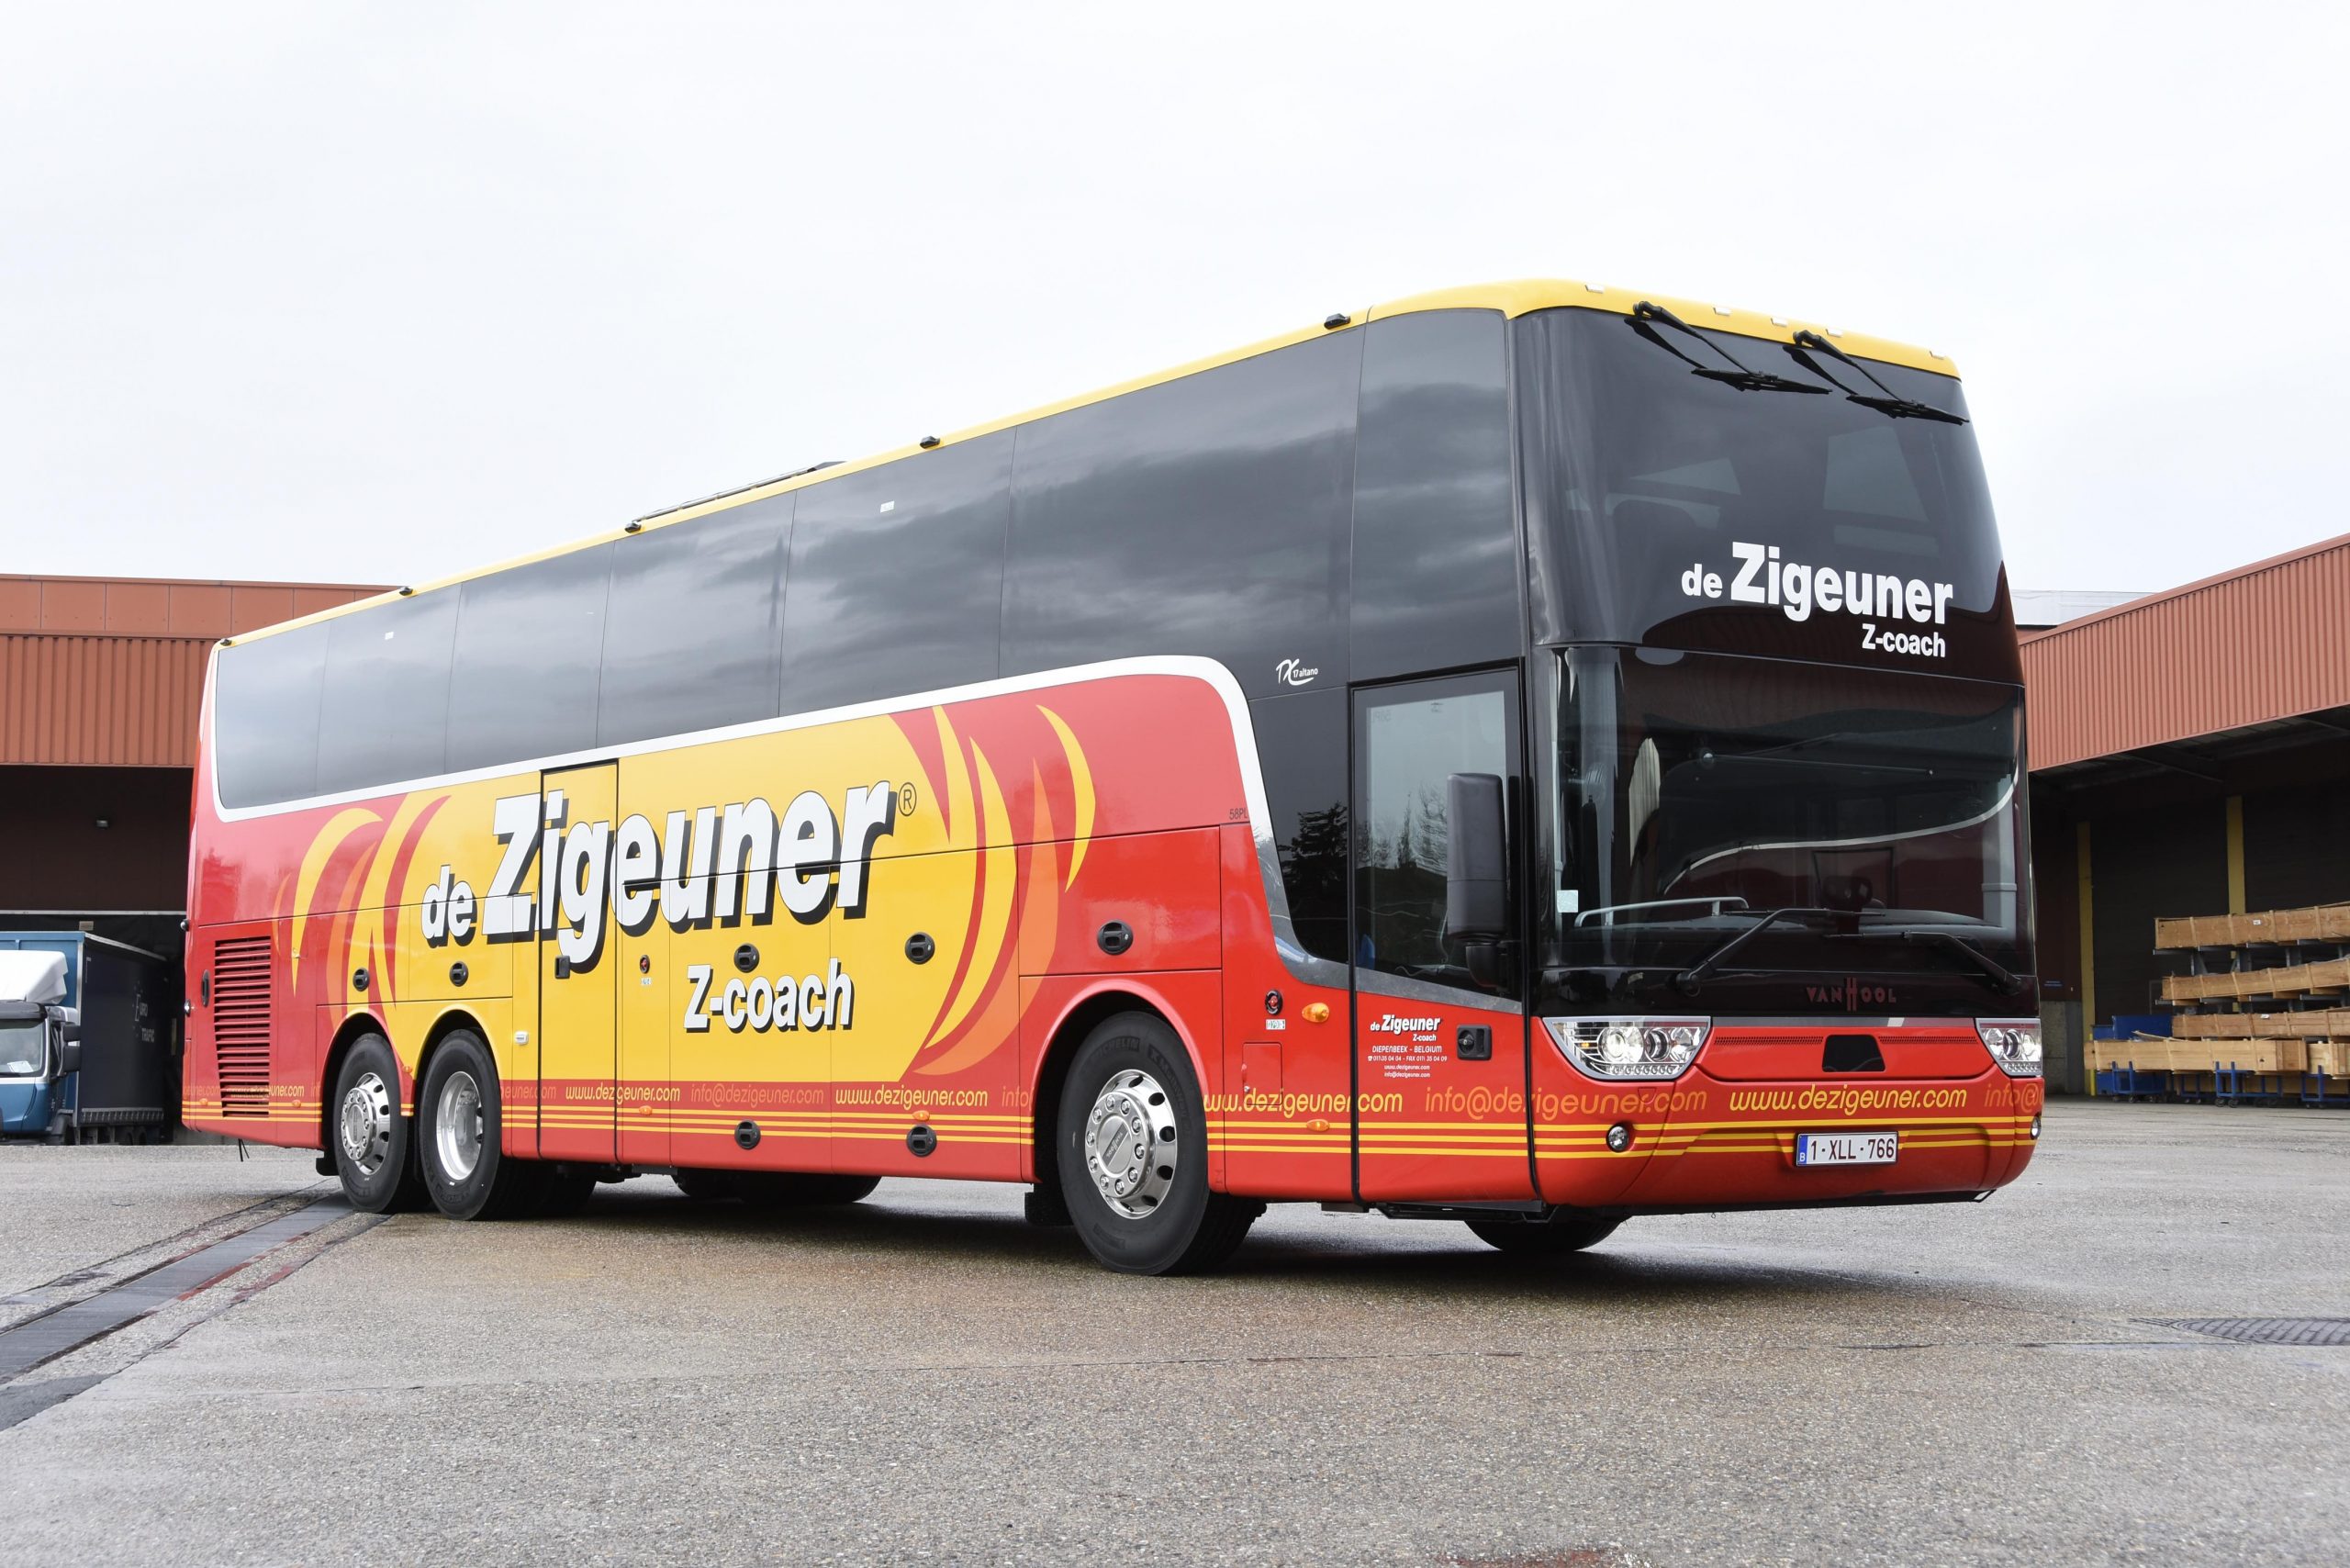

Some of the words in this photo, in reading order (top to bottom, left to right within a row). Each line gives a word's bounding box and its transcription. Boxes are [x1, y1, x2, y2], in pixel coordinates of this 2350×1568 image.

[1681, 564, 1723, 599] de
[1730, 541, 1953, 624] Zigeuner
[1862, 622, 1946, 658] Z-coach
[421, 864, 476, 947] de
[482, 780, 895, 973] Zigeuner
[683, 957, 856, 1033] Z-coach
[1370, 1021, 1381, 1031] de
[1381, 1014, 1441, 1035] Zigeuner
[1412, 1033, 1437, 1042] Z-coach
[1414, 1045, 1442, 1053] BELGIUM
[691, 1082, 824, 1107] info@dezigeuner.com
[834, 1083, 989, 1109] www.dezigeuner.com
[1729, 1083, 1967, 1115] www.dezigeuner.com
[1799, 1152, 1806, 1162] B
